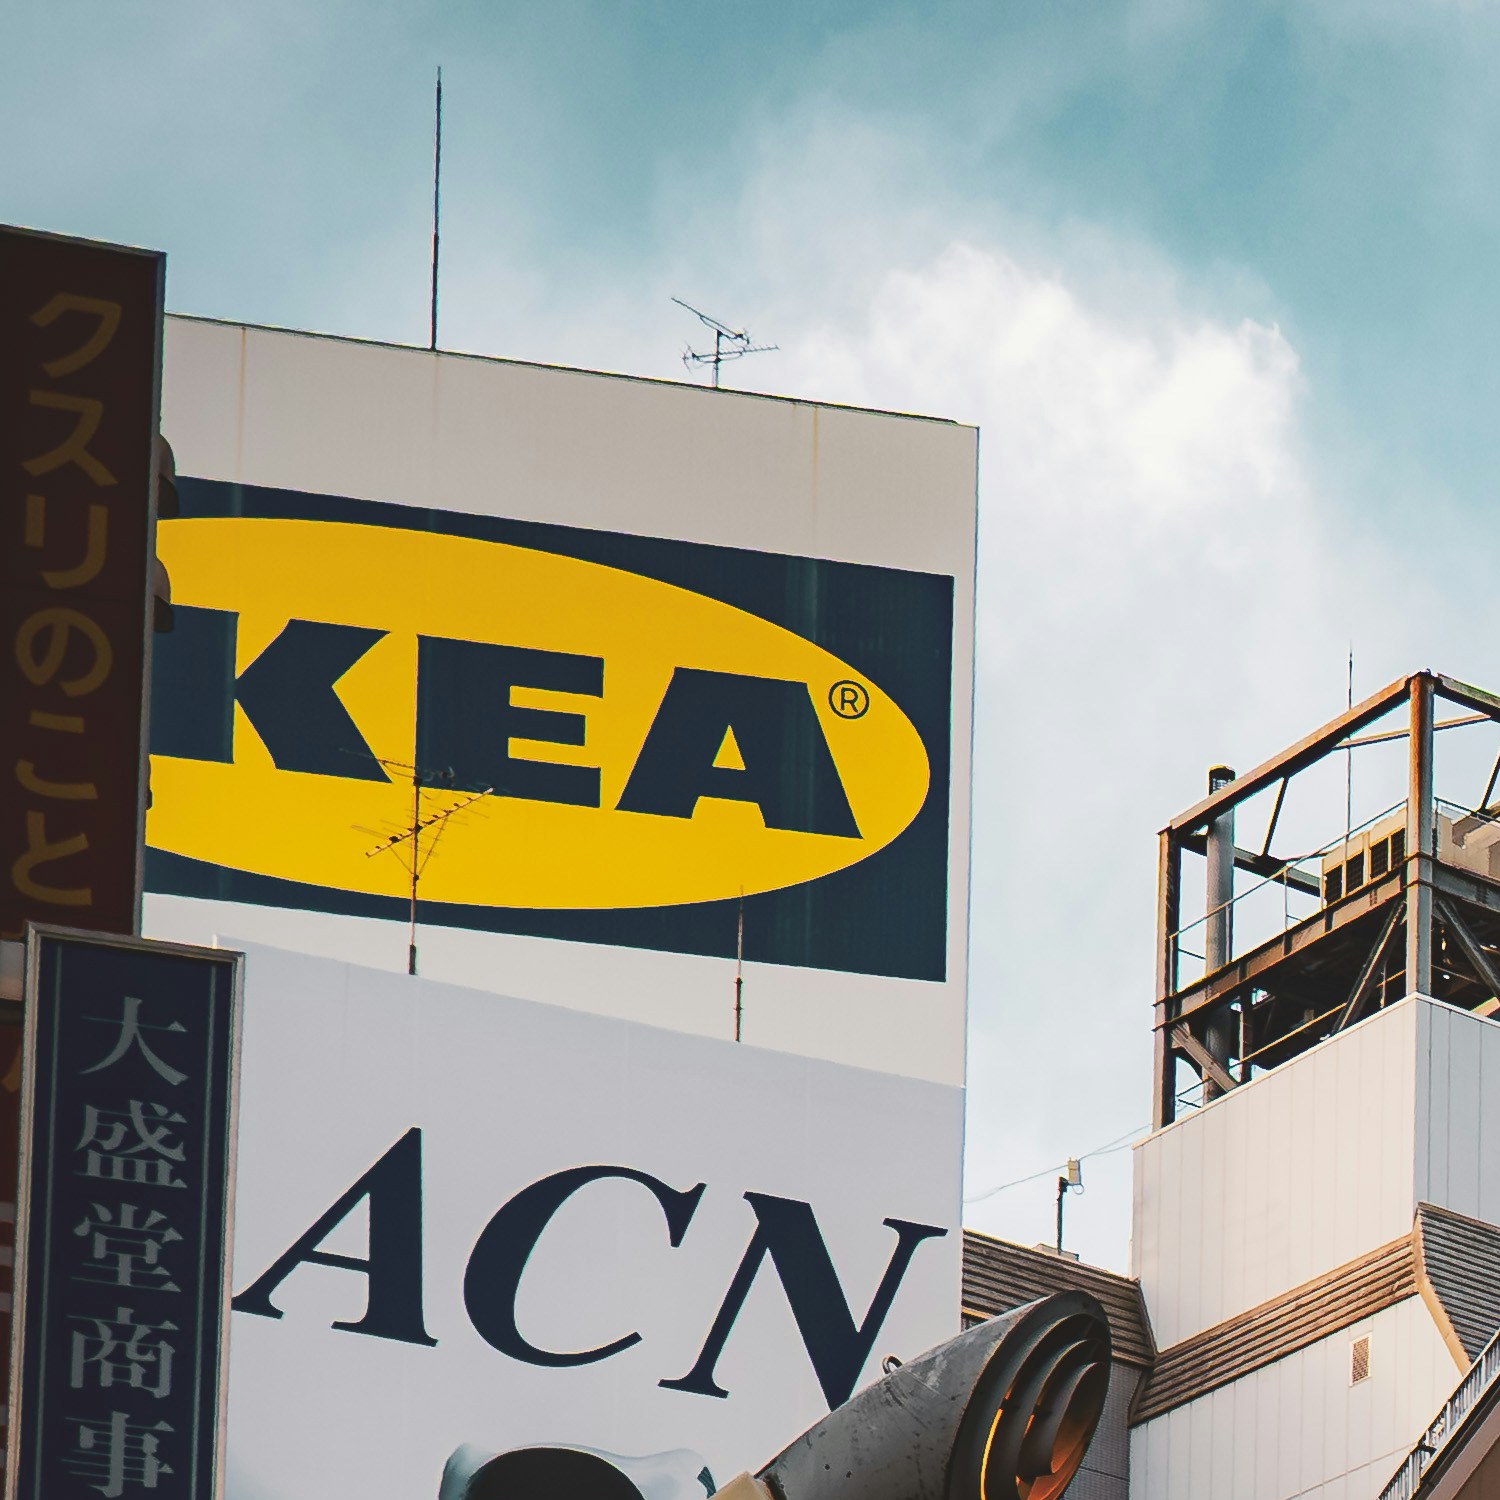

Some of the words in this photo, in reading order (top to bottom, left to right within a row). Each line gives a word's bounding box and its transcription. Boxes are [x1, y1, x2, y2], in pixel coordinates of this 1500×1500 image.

[11, 290, 124, 907] クスリのこと
[232, 1126, 948, 1412] ACN
